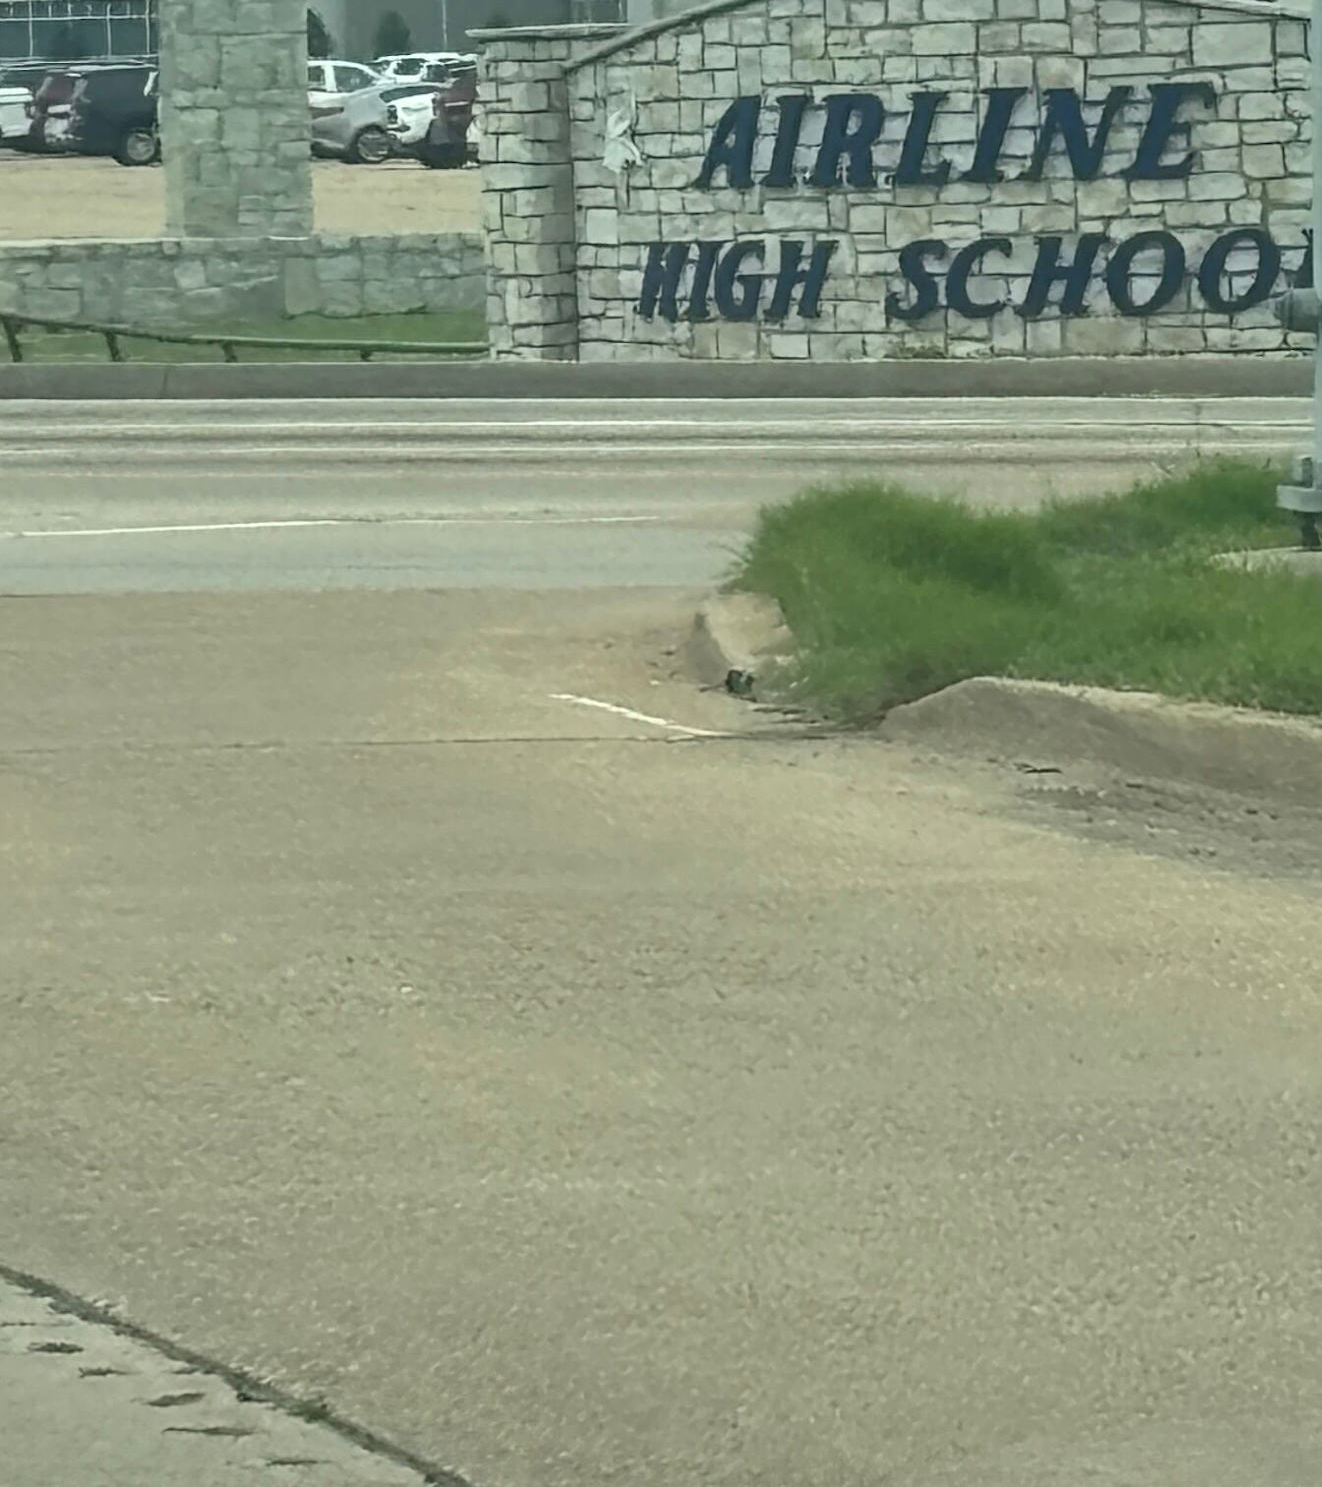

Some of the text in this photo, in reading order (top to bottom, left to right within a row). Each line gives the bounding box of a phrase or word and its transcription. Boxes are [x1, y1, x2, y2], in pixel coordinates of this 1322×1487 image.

[694, 80, 1216, 192] AIRLINE
[637, 227, 1314, 325] HIGH SCHOO
